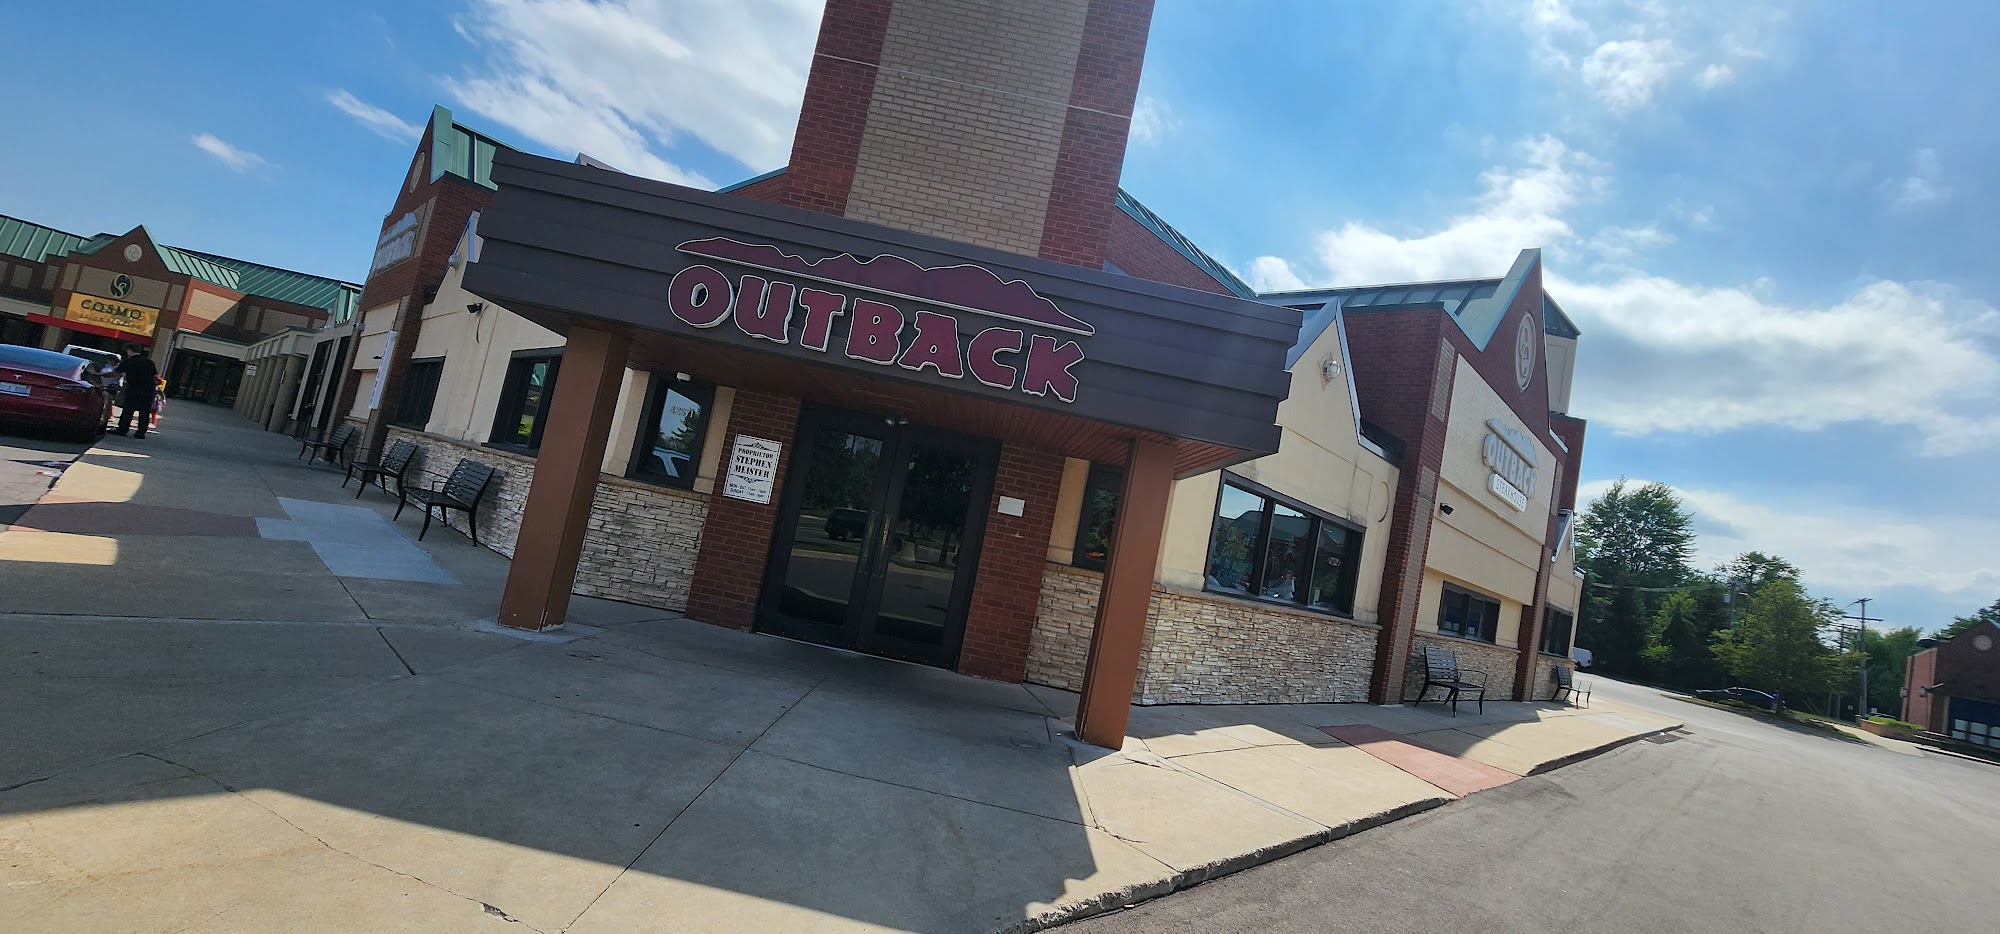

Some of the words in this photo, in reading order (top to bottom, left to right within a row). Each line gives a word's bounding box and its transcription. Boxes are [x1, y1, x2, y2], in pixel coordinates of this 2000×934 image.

[81, 299, 142, 319] COSMO
[668, 265, 1085, 403] OUTBACK
[735, 455, 773, 468] STEPHEN
[738, 448, 773, 458] PROPRIETOR
[733, 465, 770, 478] MEISTER
[1482, 433, 1537, 500] OUTBACK
[1495, 478, 1526, 509] STEAKHOUSE
